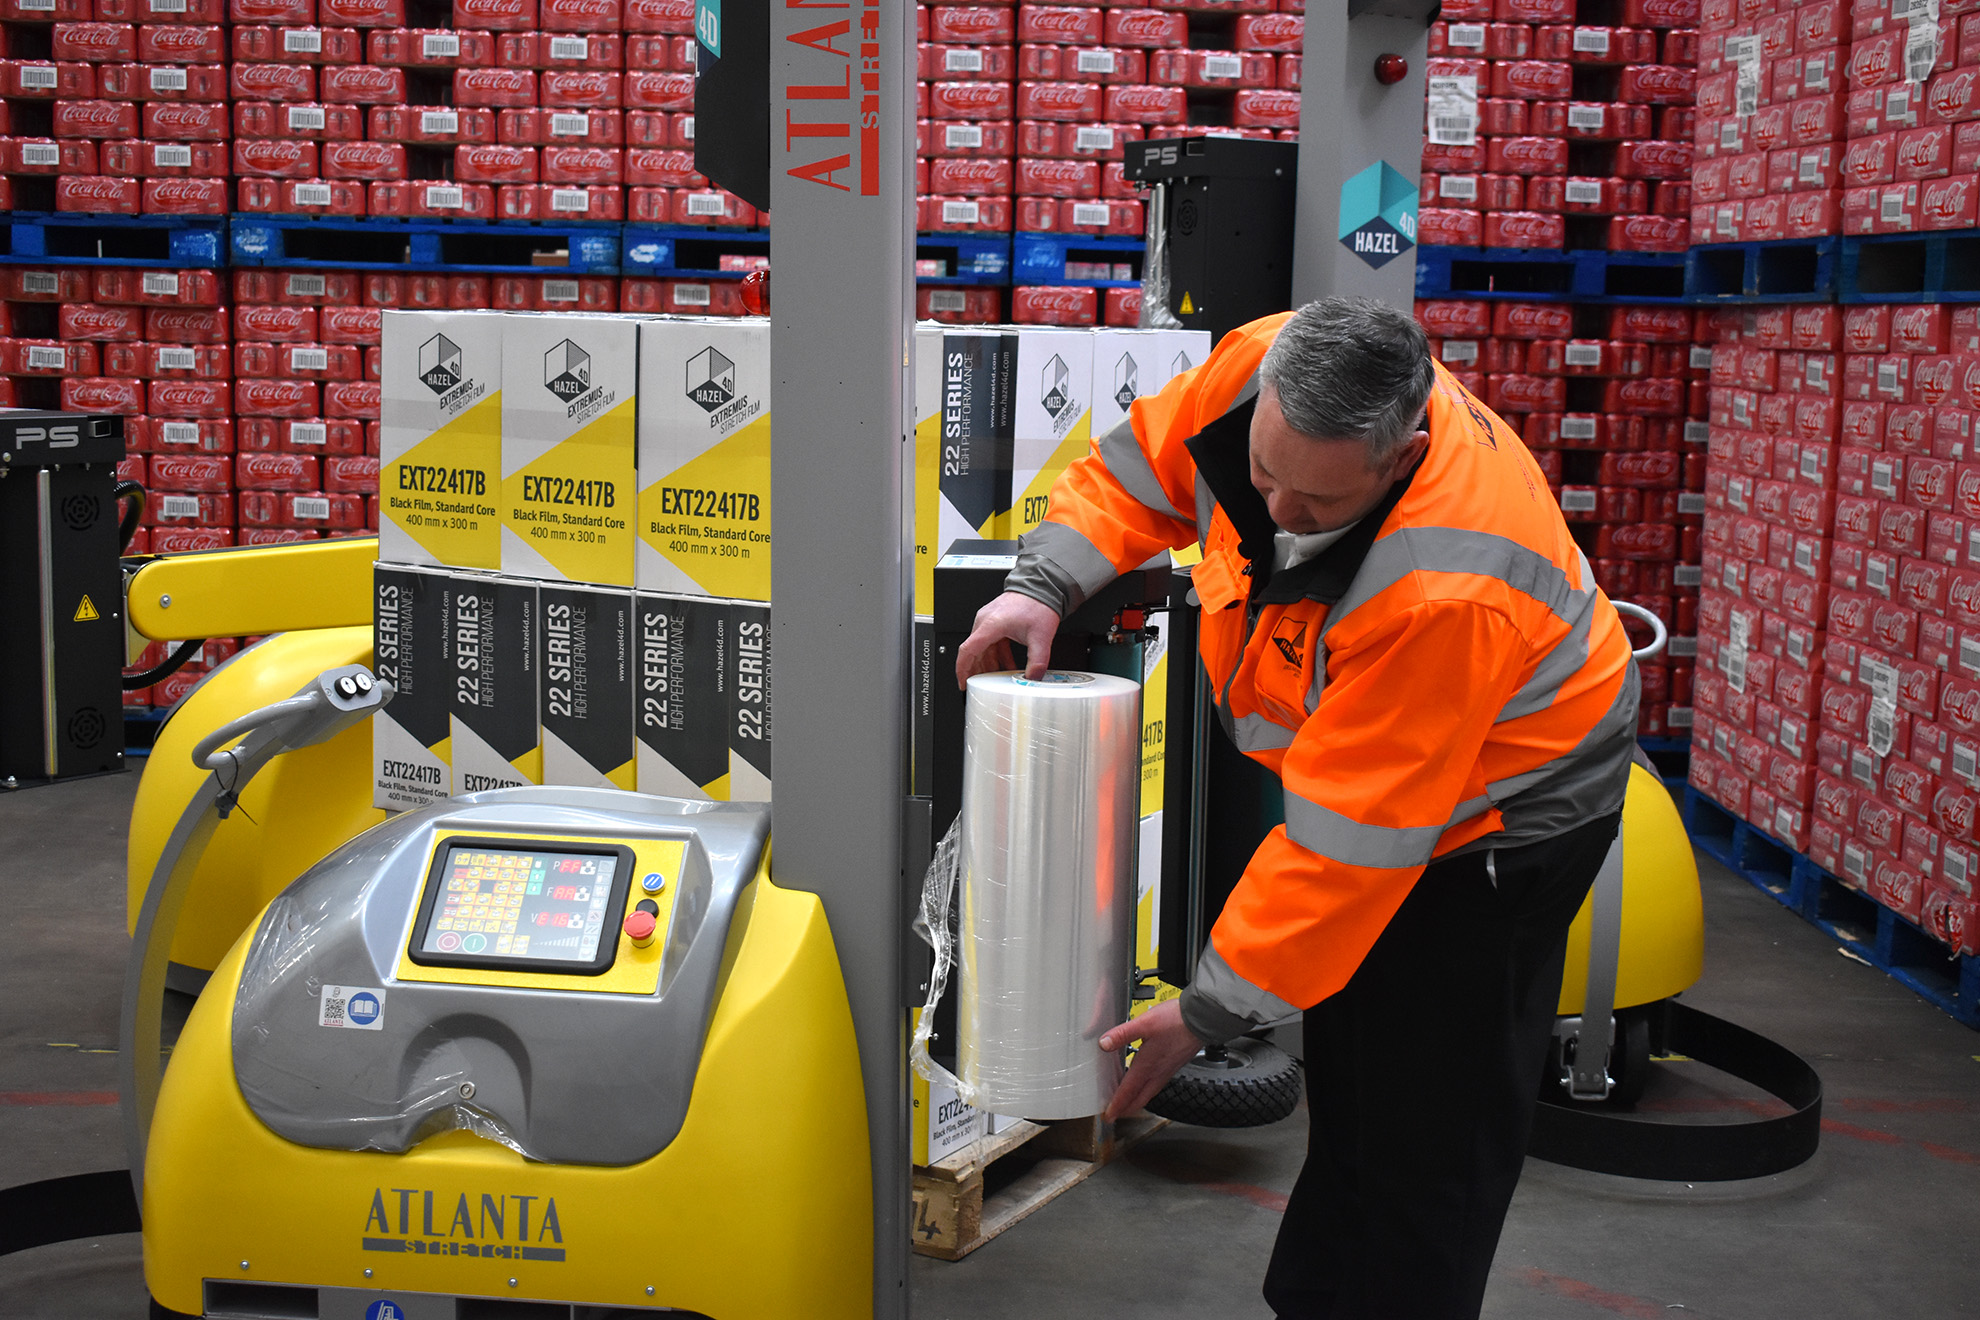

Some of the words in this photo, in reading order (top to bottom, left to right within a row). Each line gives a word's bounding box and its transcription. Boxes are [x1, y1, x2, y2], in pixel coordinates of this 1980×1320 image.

[700, 6, 717, 47] 4D
[786, 0, 850, 192] ATLA
[1145, 147, 1177, 166] PS
[1399, 212, 1415, 238] 4D
[1355, 232, 1399, 253] HAZEL
[428, 374, 451, 386] HAZEL
[450, 361, 459, 376] 4D
[579, 368, 588, 383] 4D
[441, 378, 473, 409] EXTREMUS
[449, 390, 472, 415] STRETCH
[474, 383, 485, 399] FILM
[554, 381, 580, 393] HAZEL
[697, 390, 723, 402] HAZEL
[722, 377, 732, 392] 4D
[946, 353, 963, 437] SERIES
[962, 353, 973, 446] PERFORMANCE
[1000, 352, 1009, 426] www.hazel4d.com
[568, 386, 602, 418] EXTREMUS
[577, 400, 601, 423] STRETCH
[603, 391, 615, 407] FILM
[711, 395, 748, 428] EXTREMUS
[721, 409, 746, 434] STRETCH
[748, 400, 760, 417] FILM
[1047, 397, 1061, 408] HAZEL
[16, 426, 79, 449] PS
[945, 446, 959, 476] 22
[961, 448, 969, 475] HIGH
[400, 465, 485, 495] EXT22417B
[524, 475, 614, 507] EXT22417B
[390, 497, 412, 508] Black
[414, 500, 434, 512] Film,
[436, 501, 474, 514] Standard
[477, 505, 495, 516] Core
[514, 509, 537, 521] Black
[540, 511, 560, 524] Film,
[563, 513, 602, 527] Standard
[605, 517, 625, 529] Core
[662, 487, 759, 521] EXT22417B
[1025, 495, 1048, 524] EXT2
[406, 515, 422, 525] 400
[425, 518, 440, 527] mm
[443, 520, 448, 528] x
[450, 518, 467, 529] 300
[470, 522, 477, 530] m
[531, 527, 548, 538] 400
[551, 531, 567, 540] mm
[570, 533, 575, 541] x
[578, 531, 595, 543] 300
[598, 535, 606, 544] m
[651, 522, 676, 534] Black
[679, 525, 701, 538] Film,
[704, 527, 746, 540] Standard
[749, 531, 771, 543] Core
[670, 541, 688, 552] 400
[691, 545, 708, 554] mm
[711, 546, 717, 555] x
[720, 545, 738, 557] 300
[742, 549, 749, 558] m
[915, 543, 927, 554] re
[379, 584, 398, 659] SERIES
[401, 587, 413, 666] PERFORMANCE
[457, 595, 479, 671] SERIES
[481, 597, 493, 679] PERFORMANCE
[548, 604, 571, 682] SERIES
[573, 606, 586, 691] PERFORMANCE
[644, 613, 668, 692] SERIES
[670, 616, 684, 702] PERFORMANCE
[738, 622, 763, 703] SERIES
[401, 667, 412, 695] HIGH
[457, 676, 479, 705] 22
[921, 640, 930, 715] www.hazel4d.com
[482, 680, 493, 707] HIGH
[549, 687, 571, 717] 22
[575, 693, 586, 719] HIGH
[644, 698, 667, 728] 22
[671, 704, 684, 731] HIGH
[738, 709, 762, 739] 22
[1144, 720, 1162, 747] 417B
[465, 774, 522, 791] EXT224
[365, 1188, 563, 1243] ATLANTA
[404, 1239, 522, 1260] STRETCH
